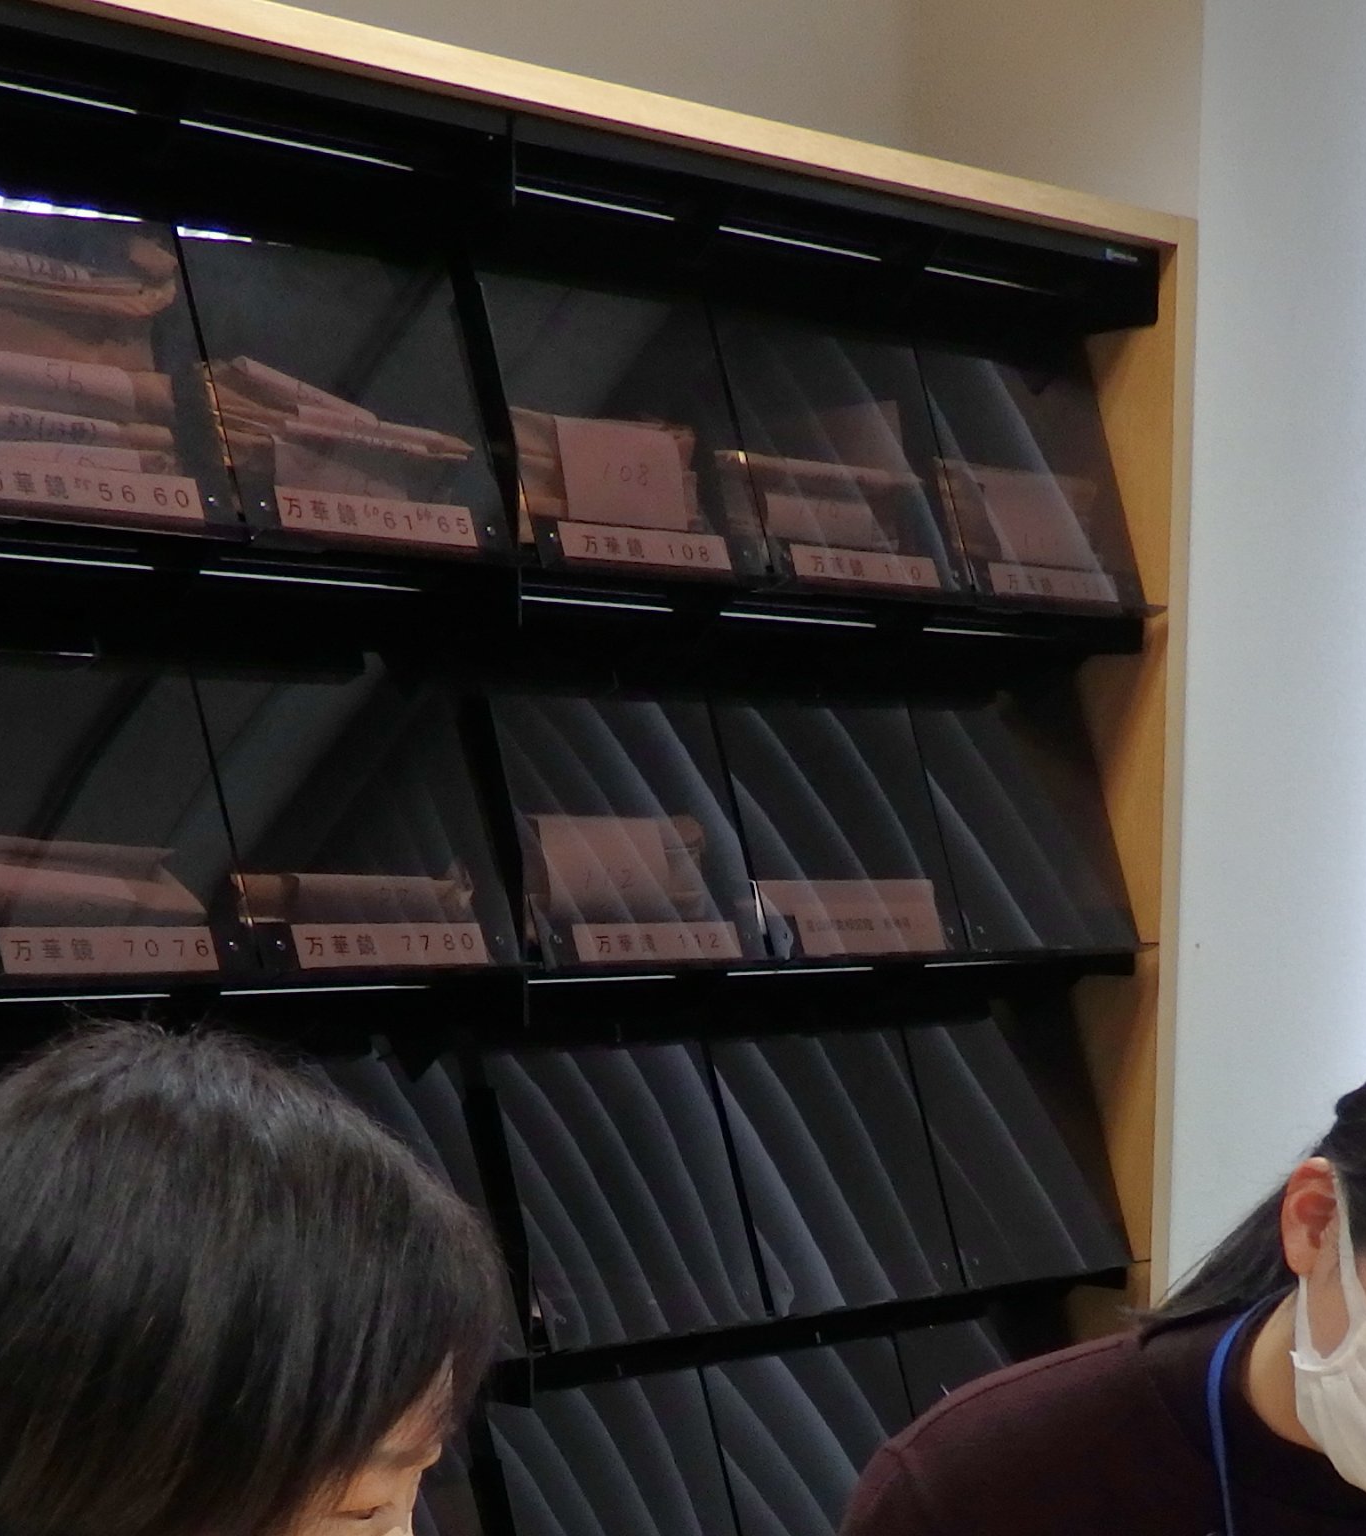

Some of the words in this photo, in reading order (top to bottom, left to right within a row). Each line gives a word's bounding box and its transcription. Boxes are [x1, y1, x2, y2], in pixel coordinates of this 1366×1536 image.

[602, 461, 650, 488] 108
[98, 482, 136, 504] 56
[153, 487, 190, 509] 60
[384, 512, 414, 531] 61
[437, 516, 469, 534] 65
[669, 543, 710, 562] 108
[123, 938, 159, 958] 70
[172, 938, 209, 958] 76
[401, 934, 430, 952] 77
[443, 933, 474, 951] 80
[677, 932, 720, 949] 112
